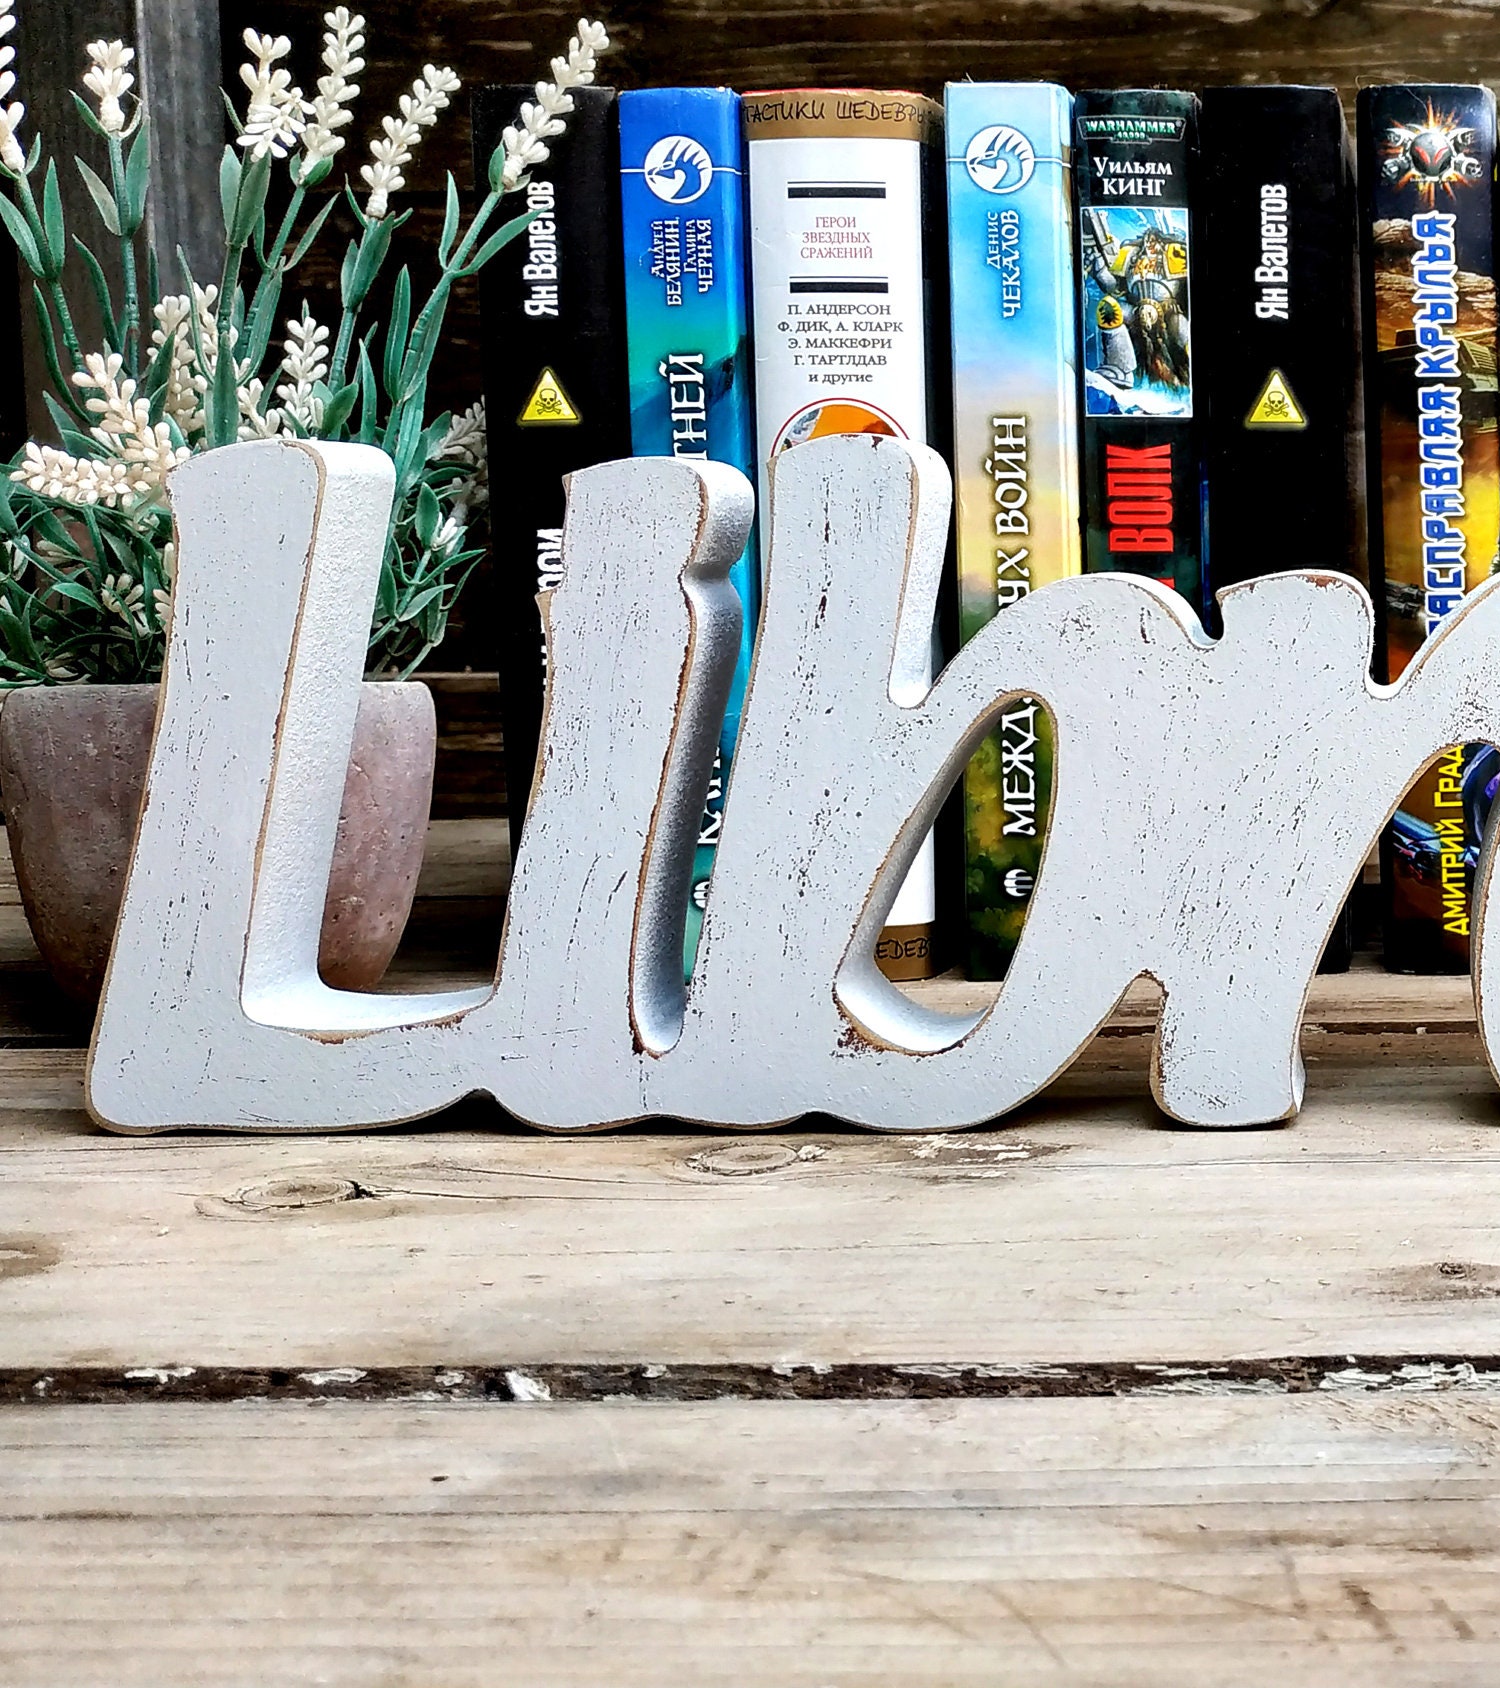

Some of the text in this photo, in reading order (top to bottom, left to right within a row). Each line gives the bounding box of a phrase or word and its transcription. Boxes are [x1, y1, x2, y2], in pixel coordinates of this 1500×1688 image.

[1085, 120, 1176, 134] WARHAMMER
[1093, 156, 1173, 178] Уильям
[1102, 178, 1166, 196] КИНГ
[815, 216, 857, 229] ГЕРОИ
[802, 231, 871, 246] ЗВЕЗДНЫХ
[664, 216, 682, 306] БЕЛЯНИН,
[697, 218, 714, 293] ЧЕРНАЯ
[800, 245, 873, 259] СРАЖЕНИЙ
[1255, 183, 1289, 319] Ян Валетов
[1000, 210, 1021, 317] ЧЕКАЛОВ
[524, 285, 559, 316] Ян
[1412, 210, 1460, 377] КРЫЛЬЯ
[788, 303, 891, 317] П. АНДЕРСОН
[777, 320, 904, 335] Ф. ДИК, А. КЛАРК
[788, 337, 893, 350] Э. МАККЕФРИ
[794, 354, 888, 367] Г. ТАРТЛДАВ
[808, 372, 873, 386] и другие
[985, 416, 1029, 535] ВОЙН
[1106, 443, 1174, 553] ВОЛК
[1001, 697, 1040, 837] МЕЖД
[1436, 818, 1470, 936] ДМИТРИЙ
